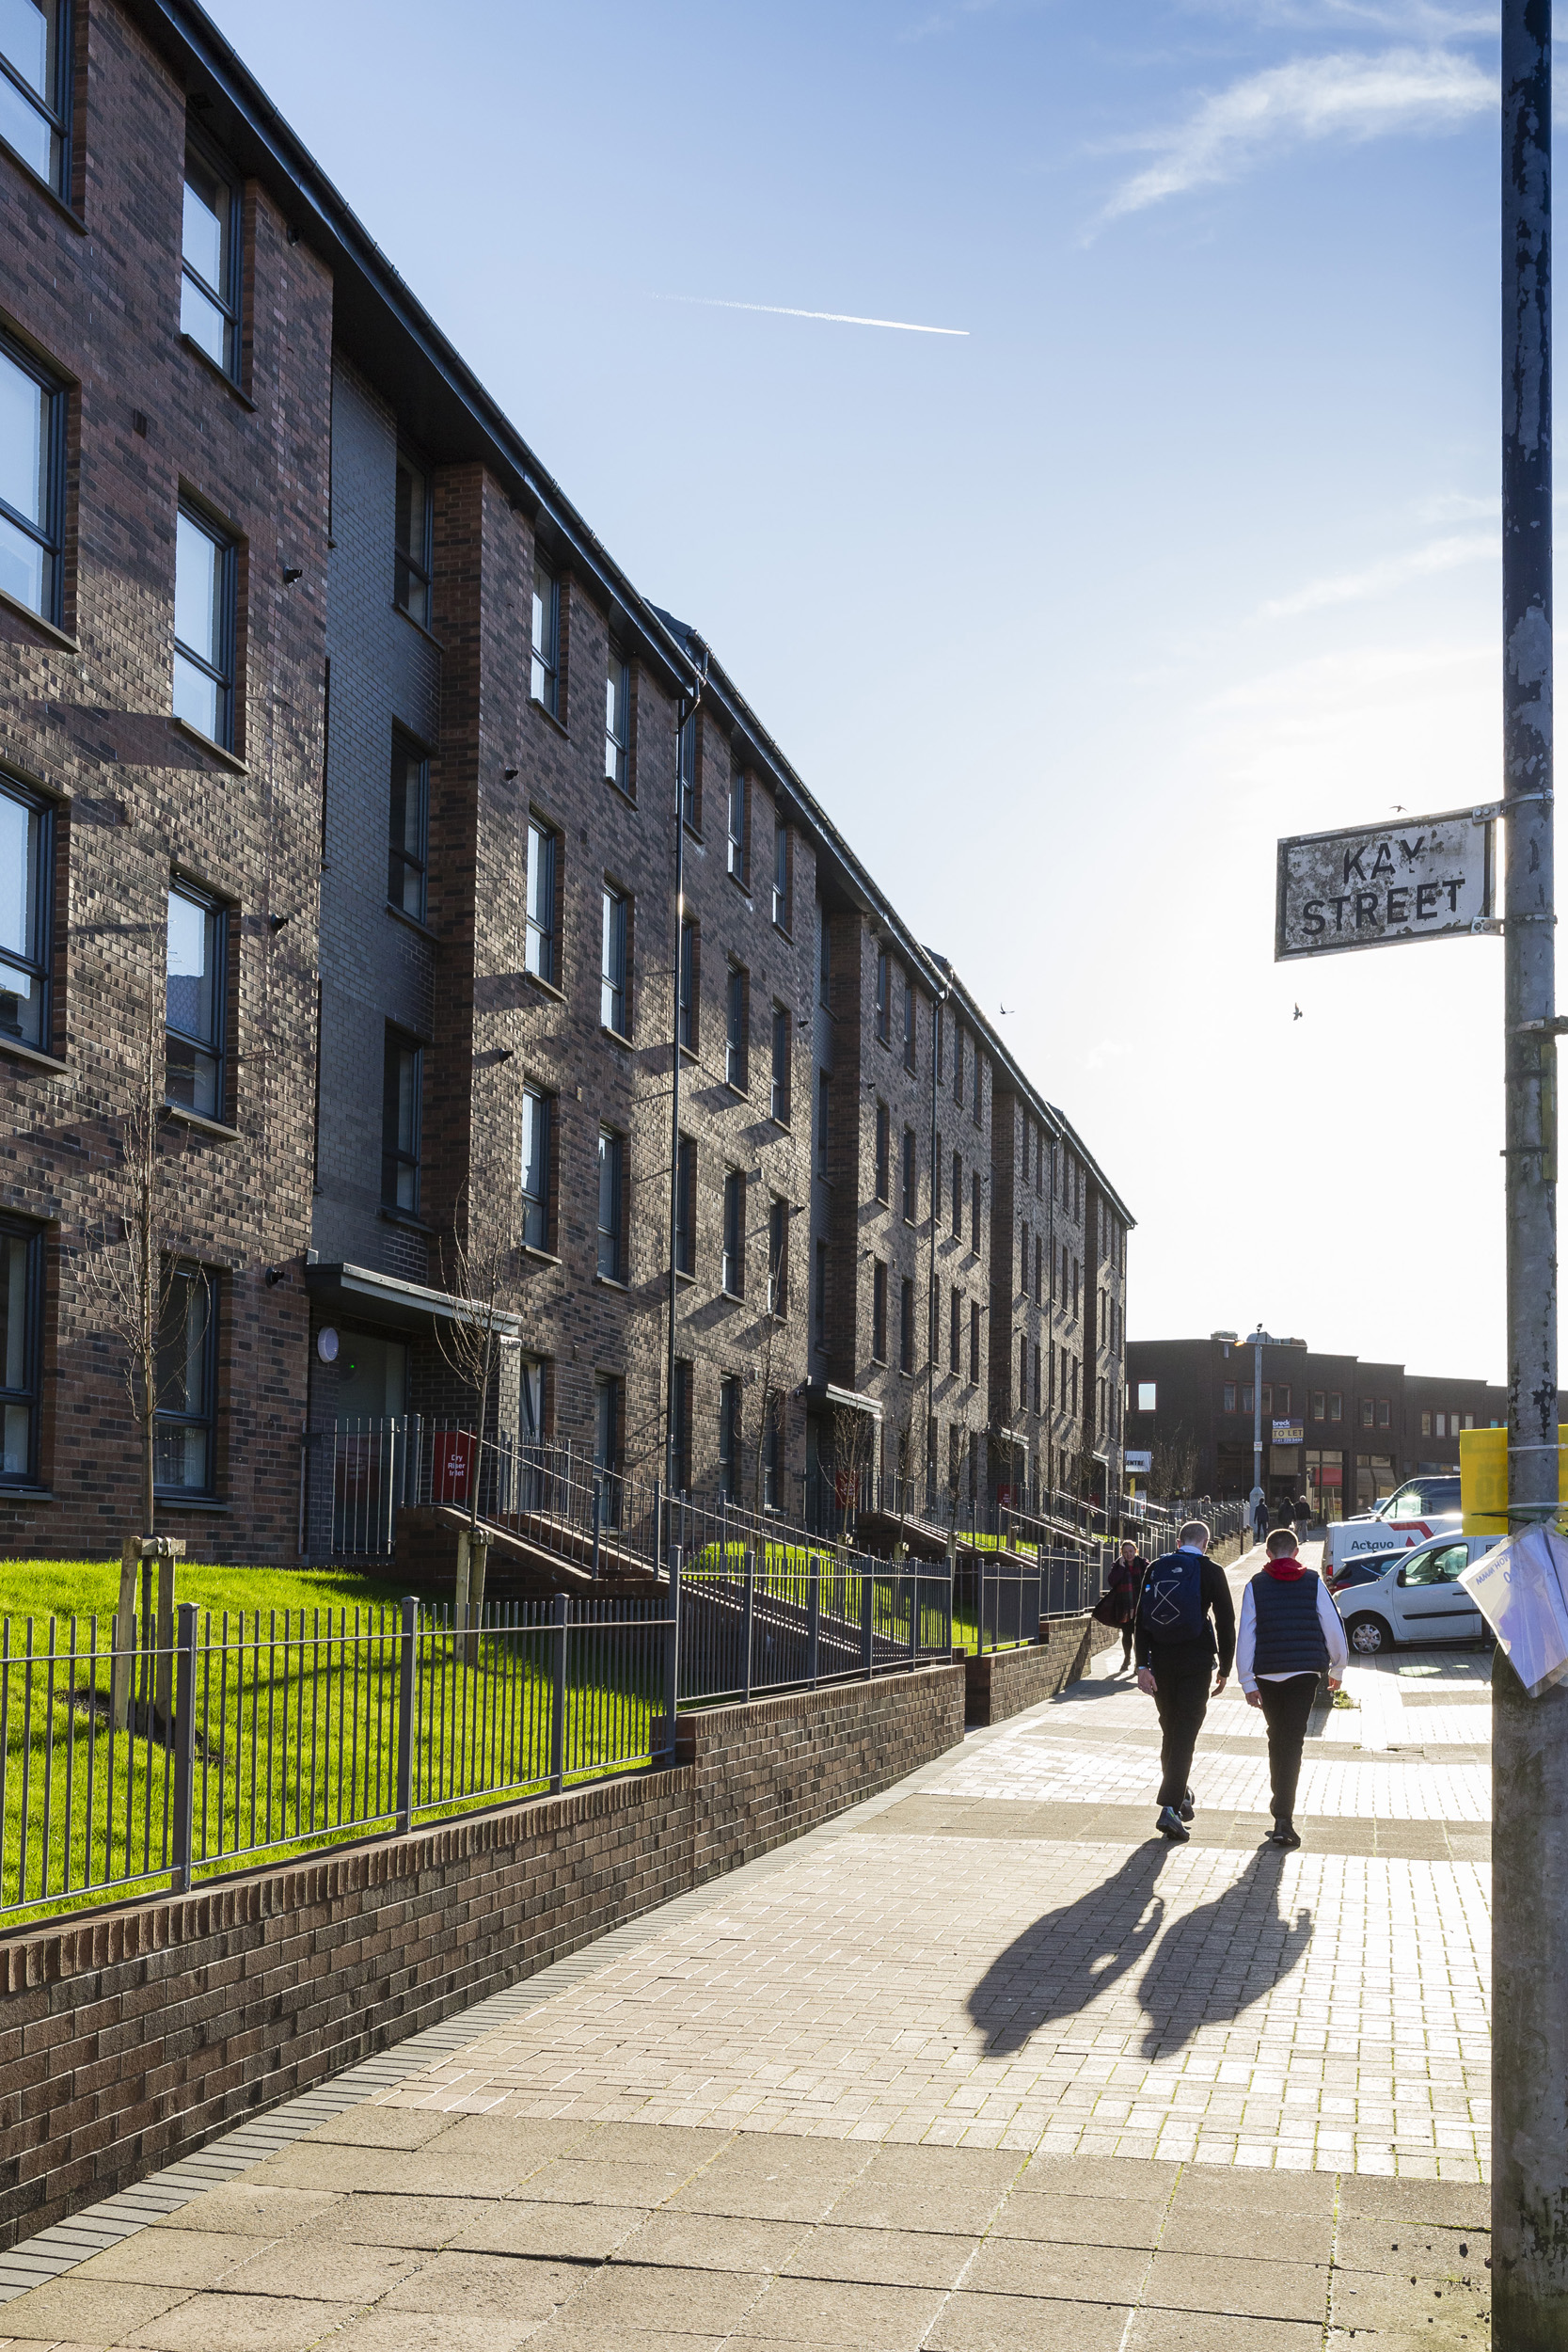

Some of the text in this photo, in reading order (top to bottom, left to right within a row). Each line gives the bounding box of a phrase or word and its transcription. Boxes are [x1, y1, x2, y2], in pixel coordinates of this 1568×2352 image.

[1343, 836, 1425, 884] KAY
[1301, 878, 1465, 936] STREET
[1351, 1540, 1394, 1550] Actavo
